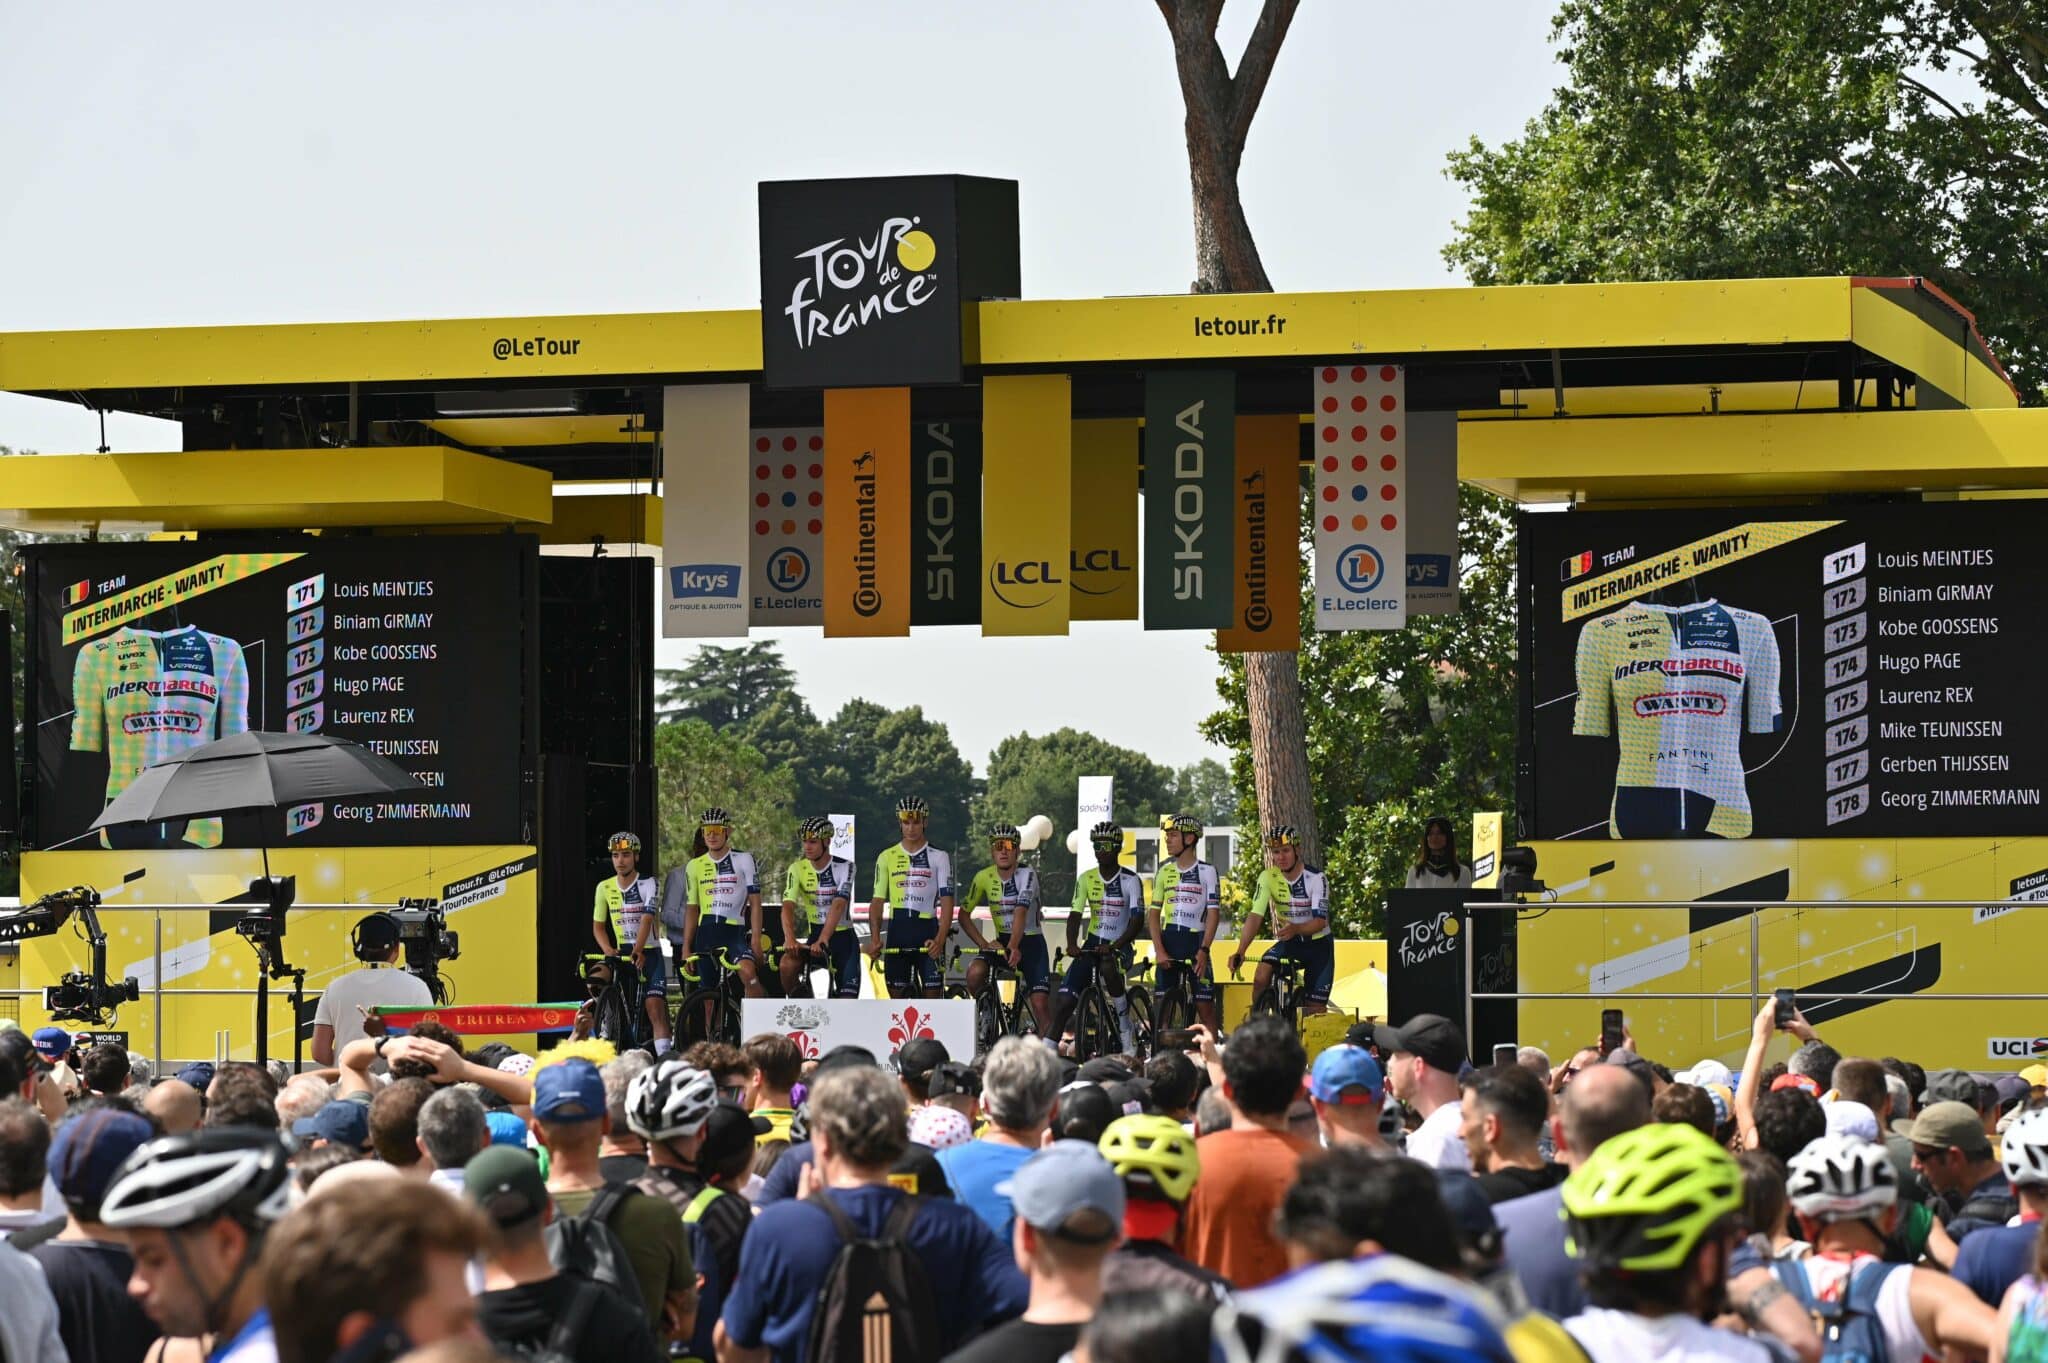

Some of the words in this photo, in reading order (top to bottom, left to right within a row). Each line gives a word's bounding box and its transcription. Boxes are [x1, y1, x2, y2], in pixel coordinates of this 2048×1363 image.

[879, 262, 900, 285] de
[1195, 314, 1286, 336] letour.fr
[493, 337, 580, 360] @LeTour
[853, 474, 882, 617] Continental
[1601, 545, 1635, 567] TEAM
[1692, 532, 1750, 566] WANTY
[1070, 549, 1131, 571] LCL
[1244, 493, 1272, 632] Continental
[1833, 553, 1856, 574] 171
[1878, 552, 1919, 568] Louis
[1923, 549, 1994, 567] MEINTJES
[175, 563, 226, 593] WANTY
[682, 571, 729, 592] Krys
[997, 561, 1062, 584] LCL
[1406, 563, 1438, 582] rys
[97, 575, 126, 595] TEAM
[295, 583, 315, 602] 171
[334, 583, 369, 598] Louis
[372, 581, 434, 597] MEINTJES
[1833, 588, 1857, 608] 172
[1878, 586, 1932, 603] Biniam
[1936, 584, 1994, 601] GIRMAY
[754, 597, 823, 609] E.Leclerc
[1323, 598, 1398, 611] E.Leclerc
[294, 615, 316, 635] 172
[334, 615, 380, 630] Biniam
[384, 613, 433, 629] GIRMAY
[1833, 622, 1857, 643] 173
[1879, 620, 1918, 636] Kobe
[1922, 618, 1999, 635] GOOSSENS
[294, 647, 316, 667] 173
[334, 646, 367, 661] Kobe
[371, 644, 437, 660] GOOSSENS
[1833, 657, 1858, 678] 174
[1879, 654, 1919, 675] Hugo
[1924, 653, 1961, 670] PAGE
[294, 679, 316, 700] 174
[334, 677, 369, 696] Hugo
[372, 676, 404, 692] PAGE
[1833, 691, 1858, 712] 175
[1880, 689, 1941, 704] Laurenz
[1946, 687, 1974, 703] REX
[1642, 696, 1717, 711] WANTY
[130, 715, 194, 728] WANTY
[294, 711, 316, 731] 175
[334, 709, 386, 724] Laurenz
[390, 708, 414, 723] REX
[1834, 725, 1858, 747] 176
[1880, 722, 1917, 739] Mike
[1920, 721, 2002, 738] TEUNISSEN
[368, 740, 439, 755] TEUNISSEN
[1649, 748, 1715, 762] FANTINI
[1834, 759, 1860, 782] 177
[1881, 756, 1937, 773] Gerben
[1941, 755, 2009, 772] THIJSSEN
[1834, 794, 1860, 816] 178
[1881, 791, 1928, 811] Georg
[1931, 789, 2040, 806] ZIMMERMANN
[294, 807, 316, 827] 178
[334, 804, 373, 823] Georg
[377, 803, 470, 819] ZIMMERMANN
[448, 876, 483, 896] letour.fr
[488, 862, 524, 882] @LeTour
[456, 1014, 527, 1026] ERITREA
[95, 1034, 122, 1042] WORLD
[1992, 1041, 2028, 1056] UCI
